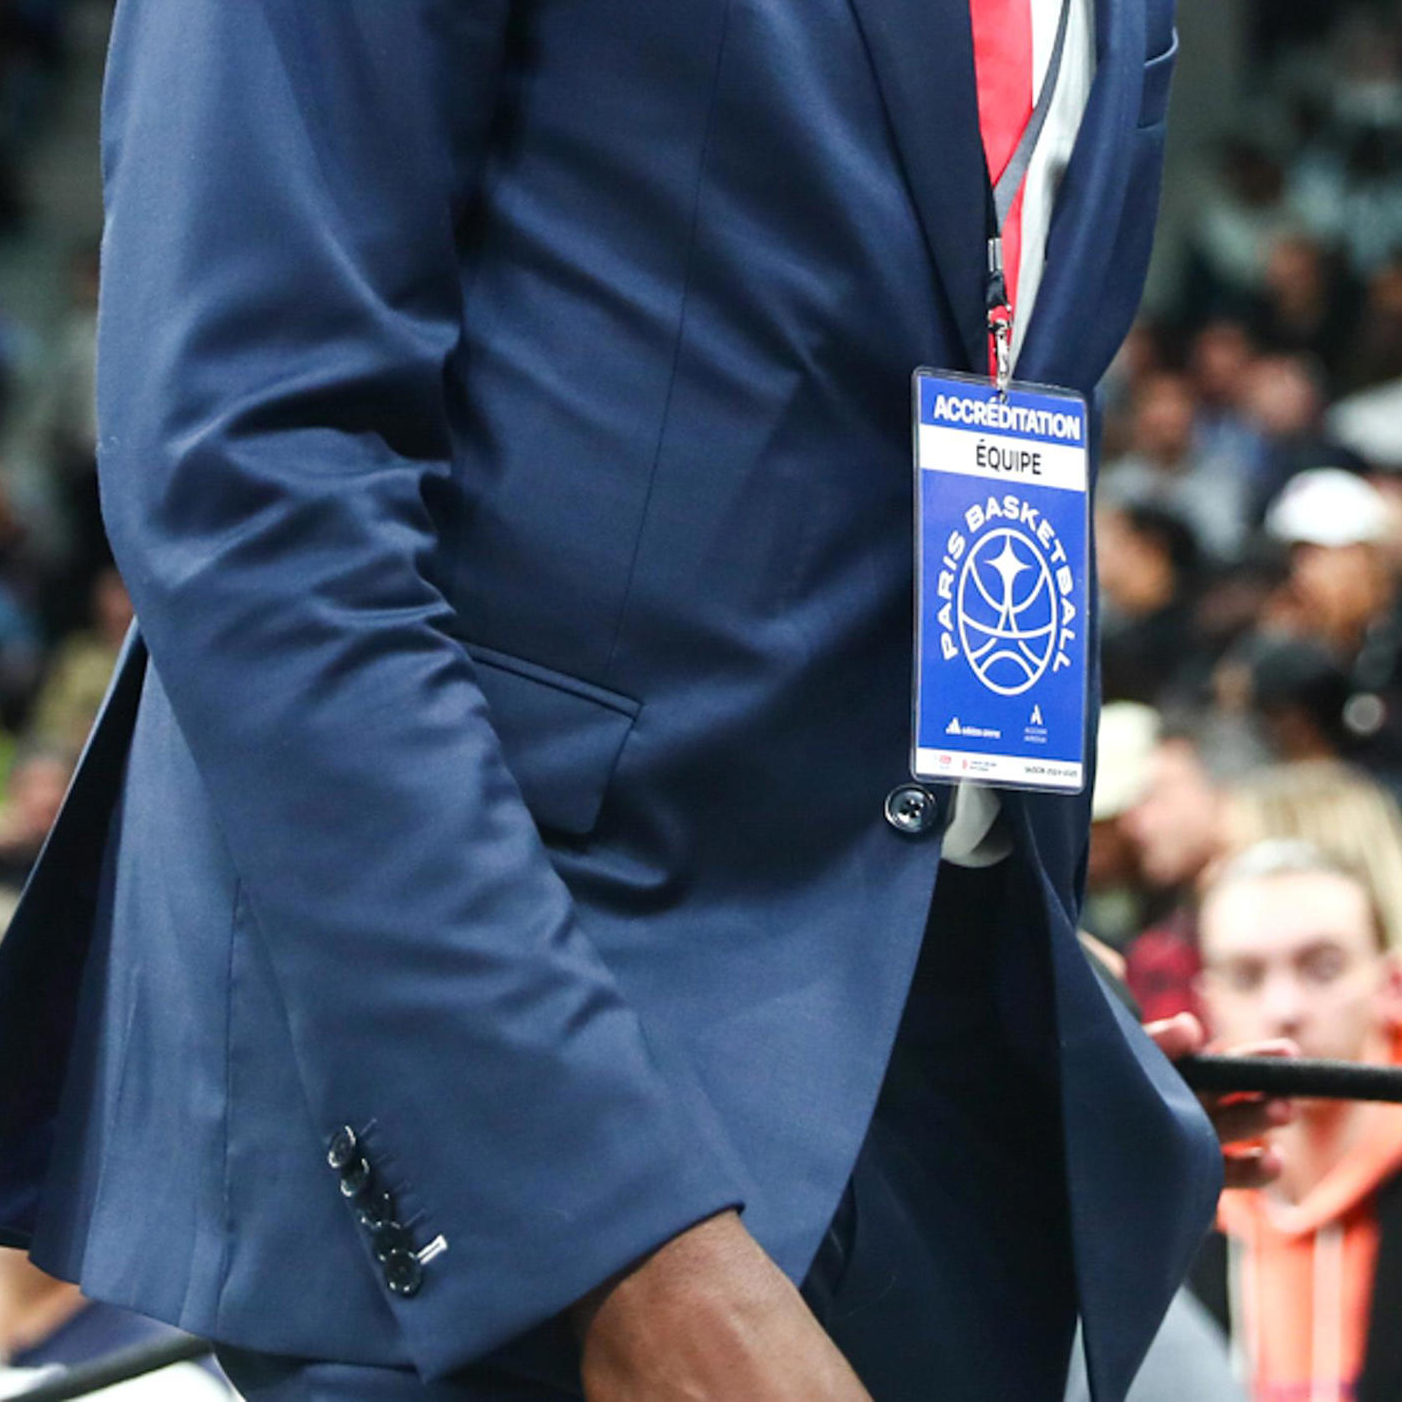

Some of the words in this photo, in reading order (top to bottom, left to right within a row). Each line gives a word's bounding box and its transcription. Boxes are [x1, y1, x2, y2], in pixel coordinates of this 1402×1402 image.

[934, 395, 1080, 440] ACCRÉDITATION
[976, 439, 1041, 475] ÉQUIPE
[937, 530, 966, 660] PARIS
[964, 495, 1076, 672] BASKETBALL
